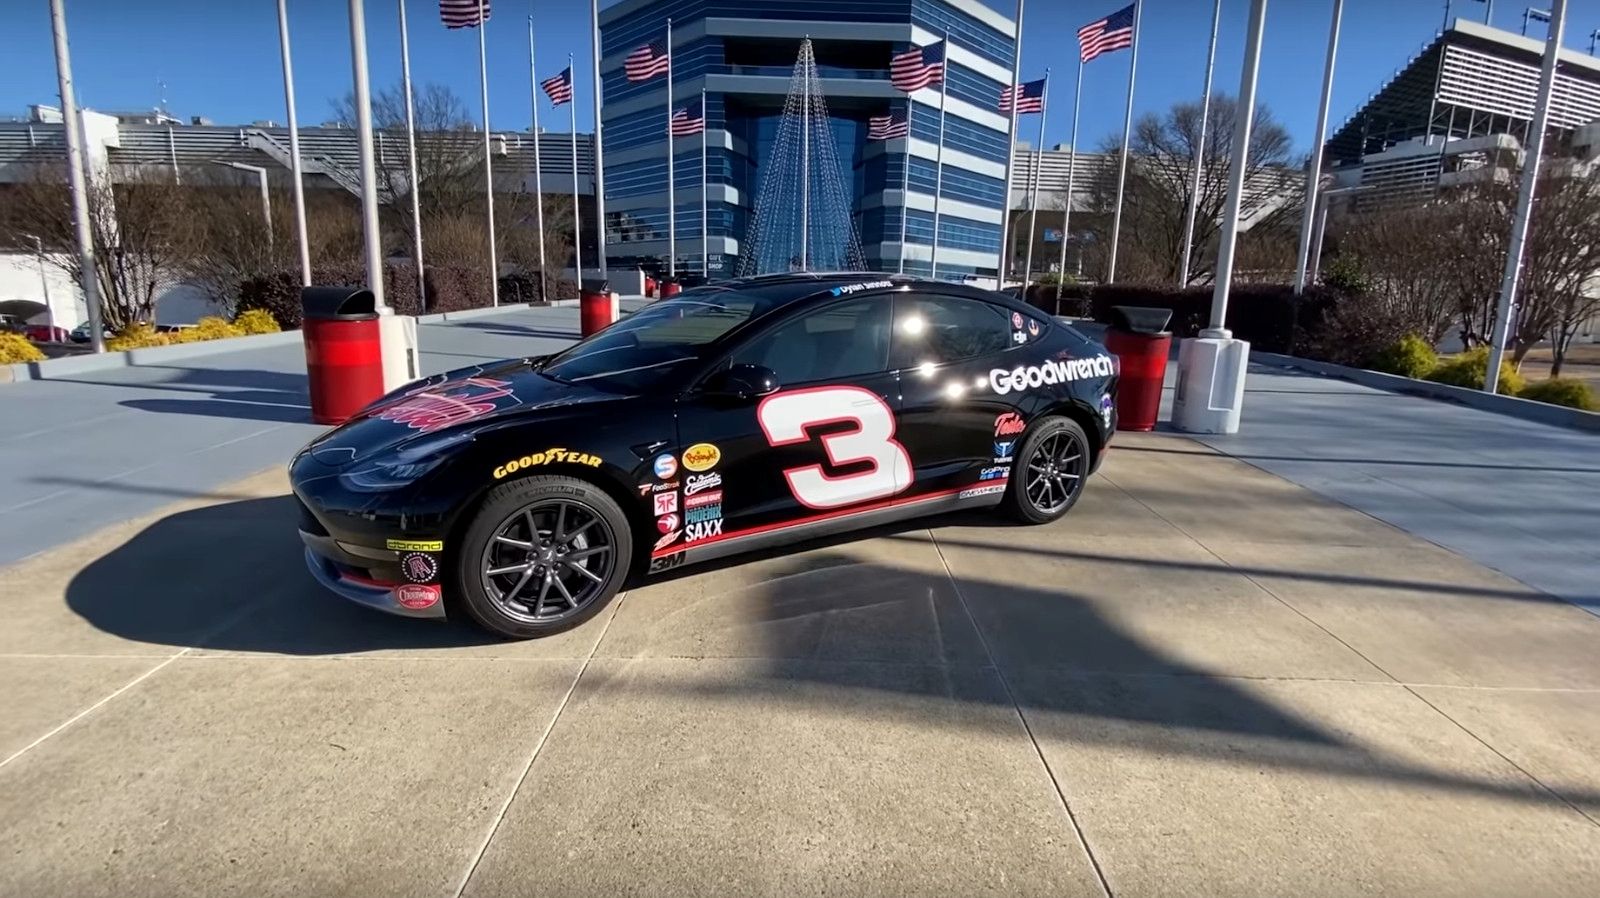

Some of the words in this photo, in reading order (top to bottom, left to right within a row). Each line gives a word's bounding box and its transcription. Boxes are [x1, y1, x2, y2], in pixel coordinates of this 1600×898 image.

[989, 353, 1114, 396] Goodwrench
[757, 385, 915, 510] 3
[493, 448, 603, 480] GOODYEAR
[388, 540, 442, 550] dbrand
[685, 519, 724, 543] SAXX
